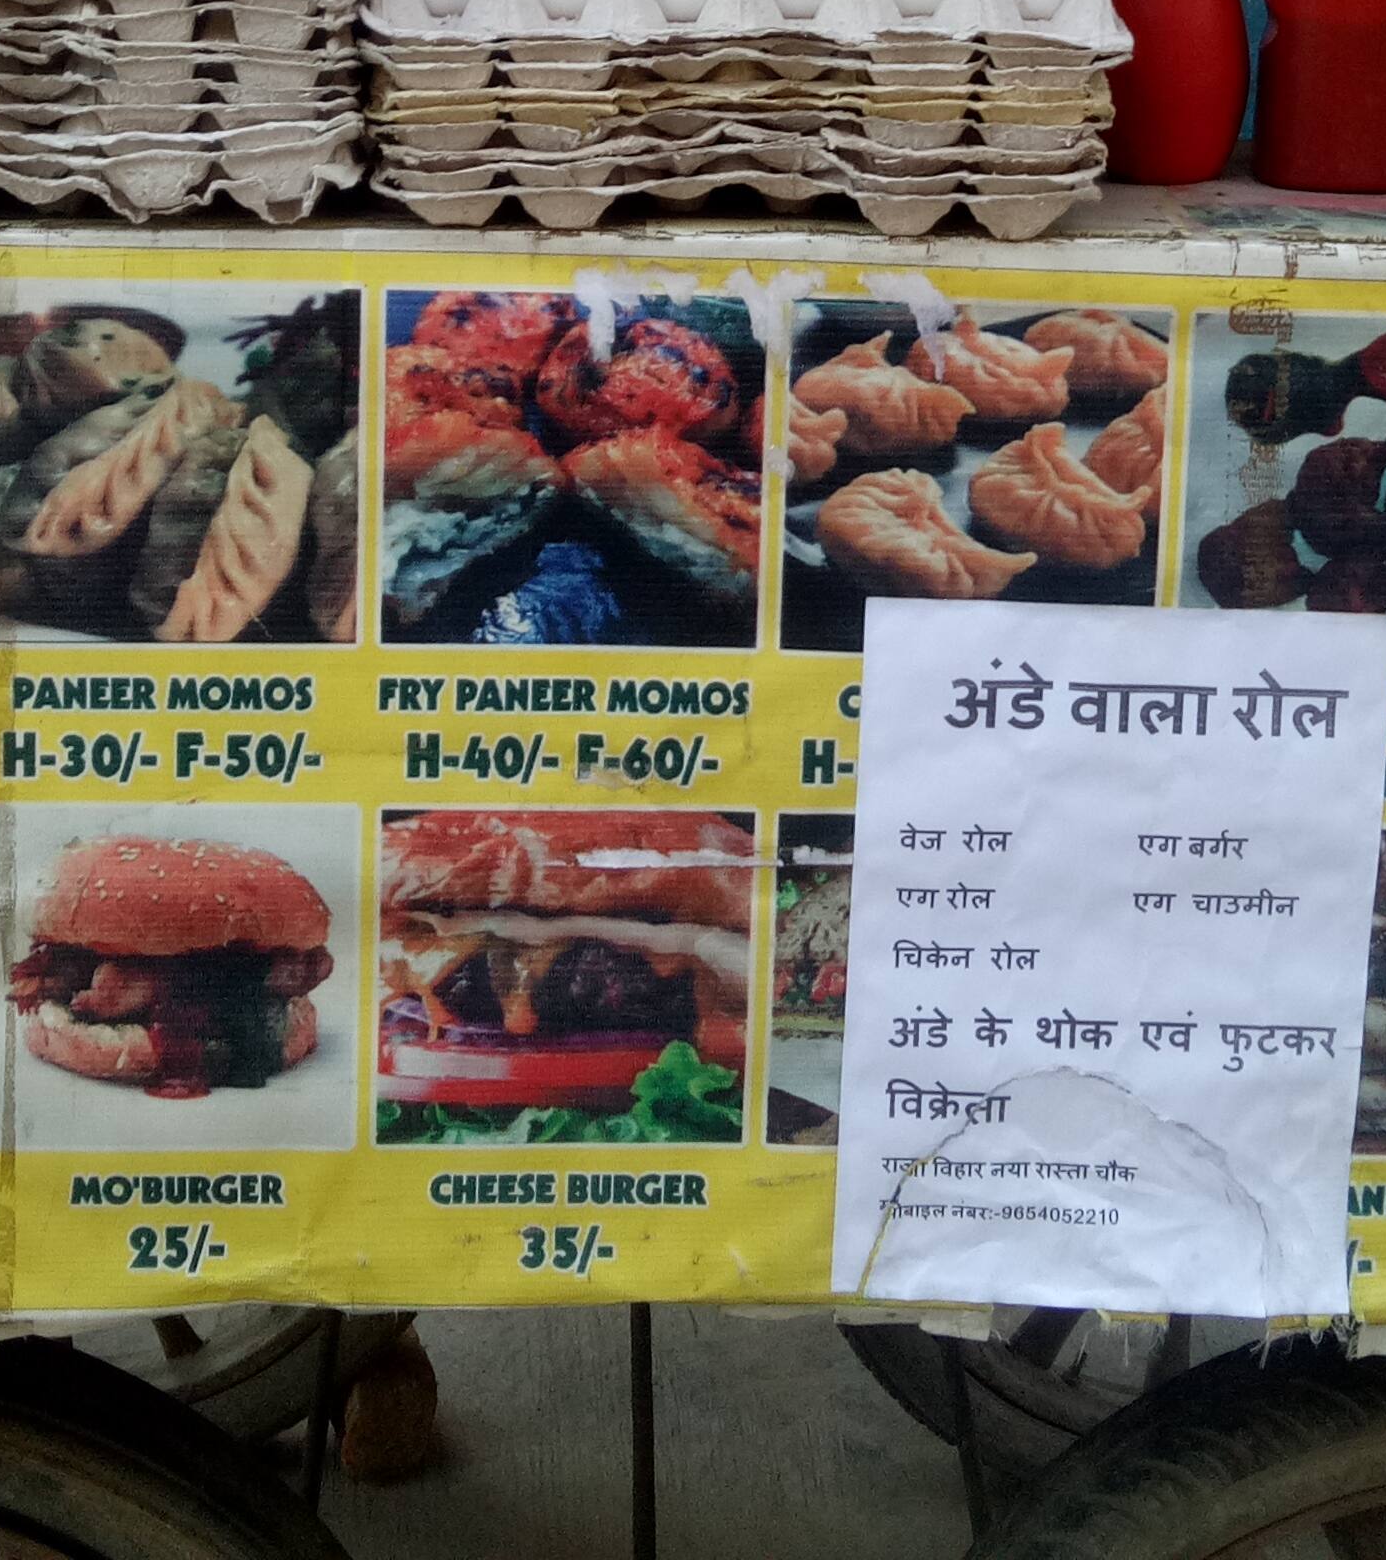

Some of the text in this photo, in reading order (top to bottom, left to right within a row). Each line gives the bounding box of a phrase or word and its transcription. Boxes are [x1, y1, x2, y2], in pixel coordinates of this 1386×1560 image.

[12, 677, 312, 711] PANEER MOMOS
[379, 678, 749, 716] FRY PANEER MOMOS
[944, 657, 1350, 741] अंडे वाला रोल
[2, 731, 321, 783] H-30/- F-50/-
[406, 732, 719, 786] H-40/- F-60/-
[899, 822, 1013, 853] वेज रोल
[1137, 829, 1249, 860] एग बर्गर
[895, 881, 996, 910] एग रोल
[1132, 888, 1300, 917] एग चाउमीन
[892, 939, 1041, 971] चिकेन रोल
[888, 1005, 1337, 1073] अंडे के थोक एवं फुटकर
[886, 1078, 1011, 1123] विक्रेता
[932, 1155, 1138, 1182] विहार नया रास्ता चौक
[70, 1174, 283, 1205] MO'BURGER
[430, 1173, 707, 1205] CHEESE BURGER
[129, 1224, 225, 1273] 25/-
[520, 1225, 614, 1274] 35/-
